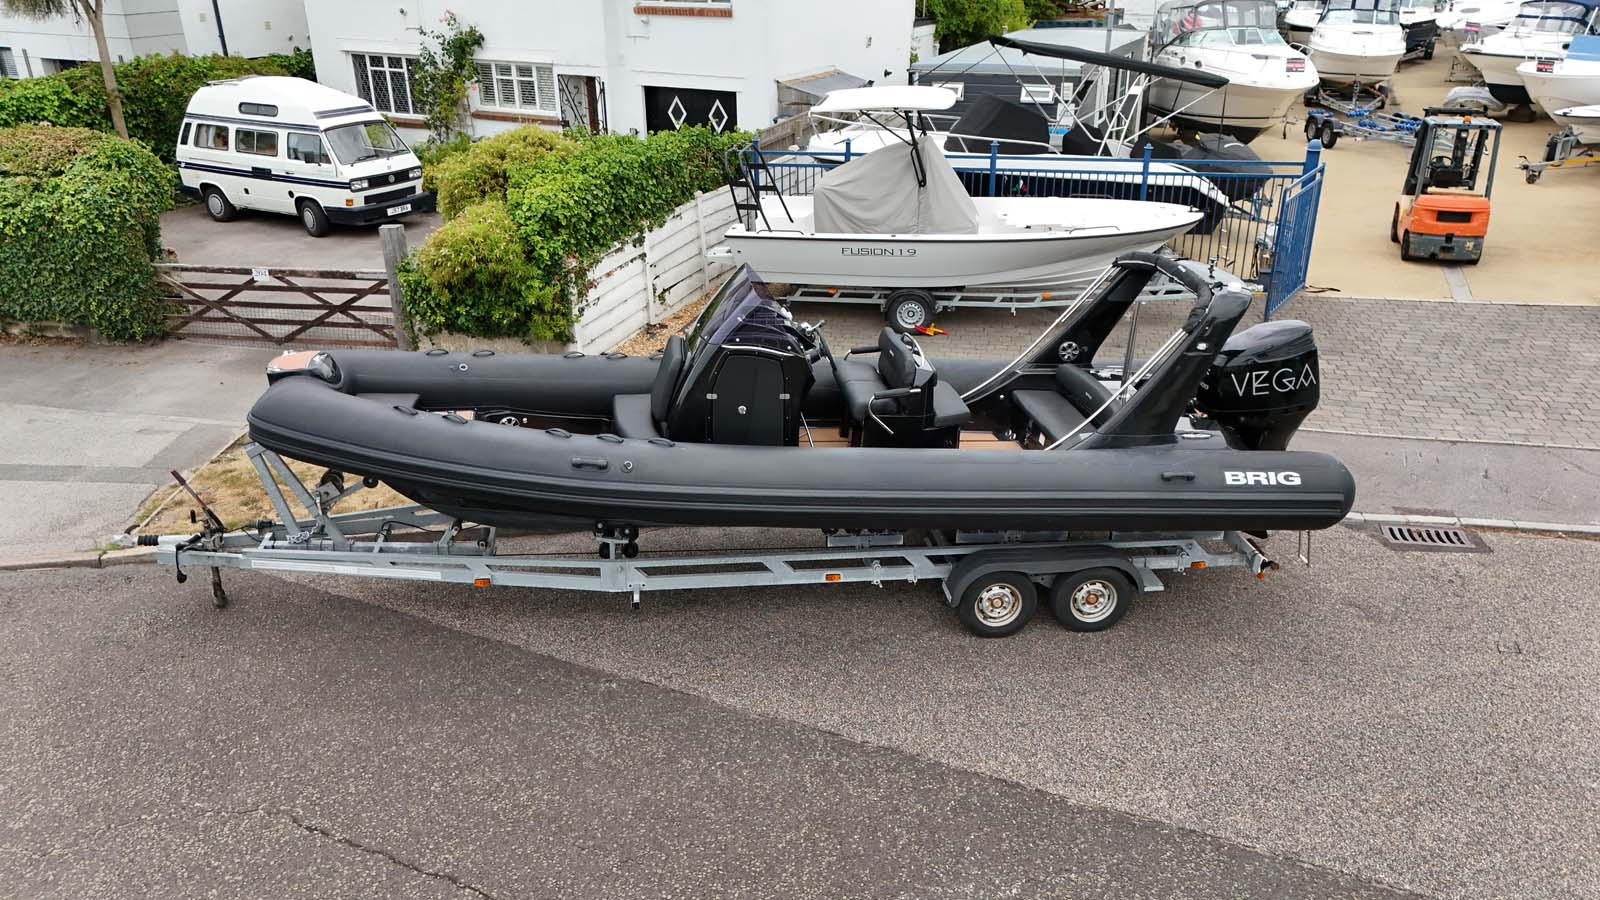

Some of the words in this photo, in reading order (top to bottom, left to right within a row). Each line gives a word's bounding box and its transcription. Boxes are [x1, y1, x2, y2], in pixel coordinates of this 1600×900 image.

[841, 247, 894, 257] FUSION
[899, 248, 917, 257] 19
[1231, 363, 1317, 397] VEGA
[1224, 471, 1302, 486] BRIG
